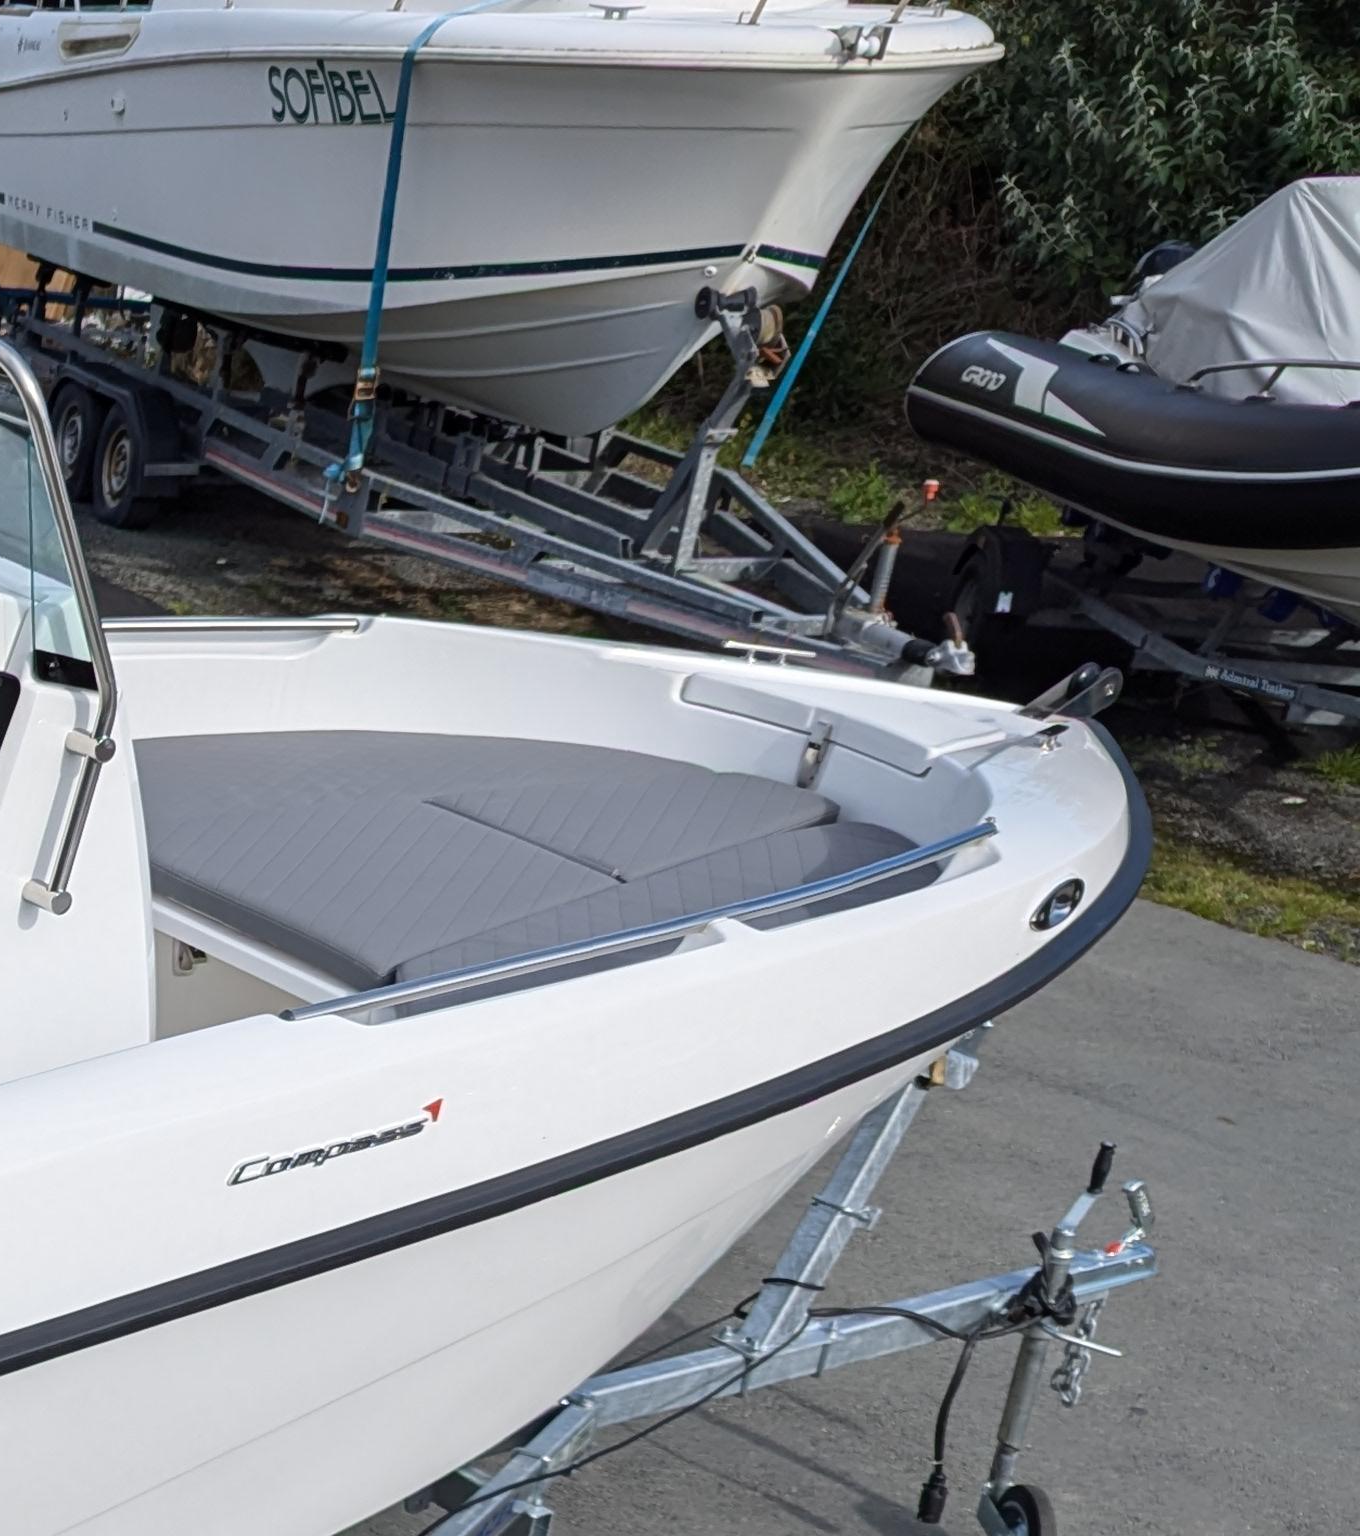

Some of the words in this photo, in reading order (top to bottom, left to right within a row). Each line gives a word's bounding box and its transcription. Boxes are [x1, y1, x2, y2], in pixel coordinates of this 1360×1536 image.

[267, 58, 397, 125] SOFIBEL
[1220, 668, 1260, 689] Admiral
[1261, 679, 1296, 700] Trailers
